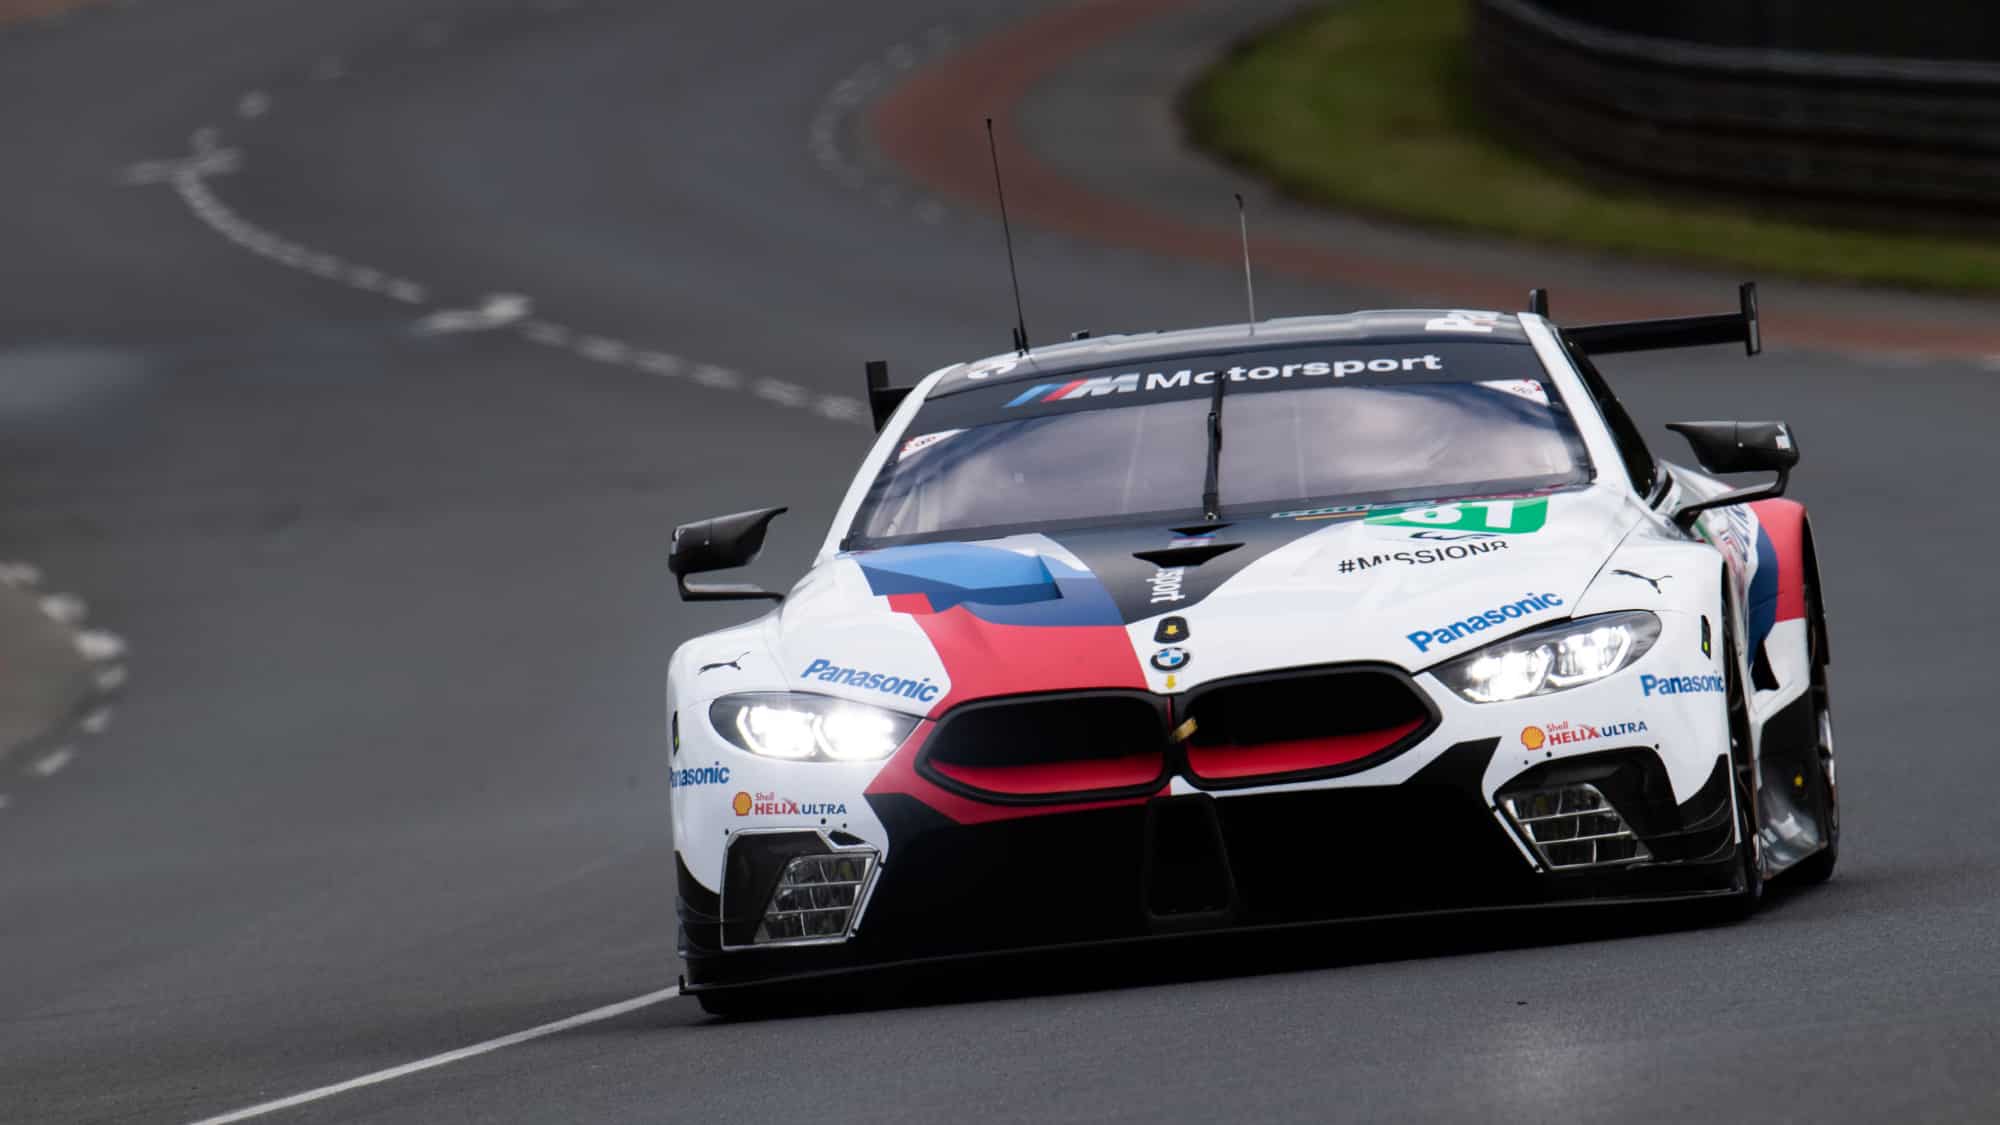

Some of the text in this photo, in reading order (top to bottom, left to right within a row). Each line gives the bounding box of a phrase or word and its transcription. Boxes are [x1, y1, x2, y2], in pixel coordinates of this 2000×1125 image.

[1145, 354, 1443, 390] Motorsport
[1407, 592, 1564, 653] Panasonic
[800, 658, 939, 702] Panasonic
[1548, 720, 1648, 746] HELIX ULTRA
[754, 800, 847, 816] HELIX ULTRA
